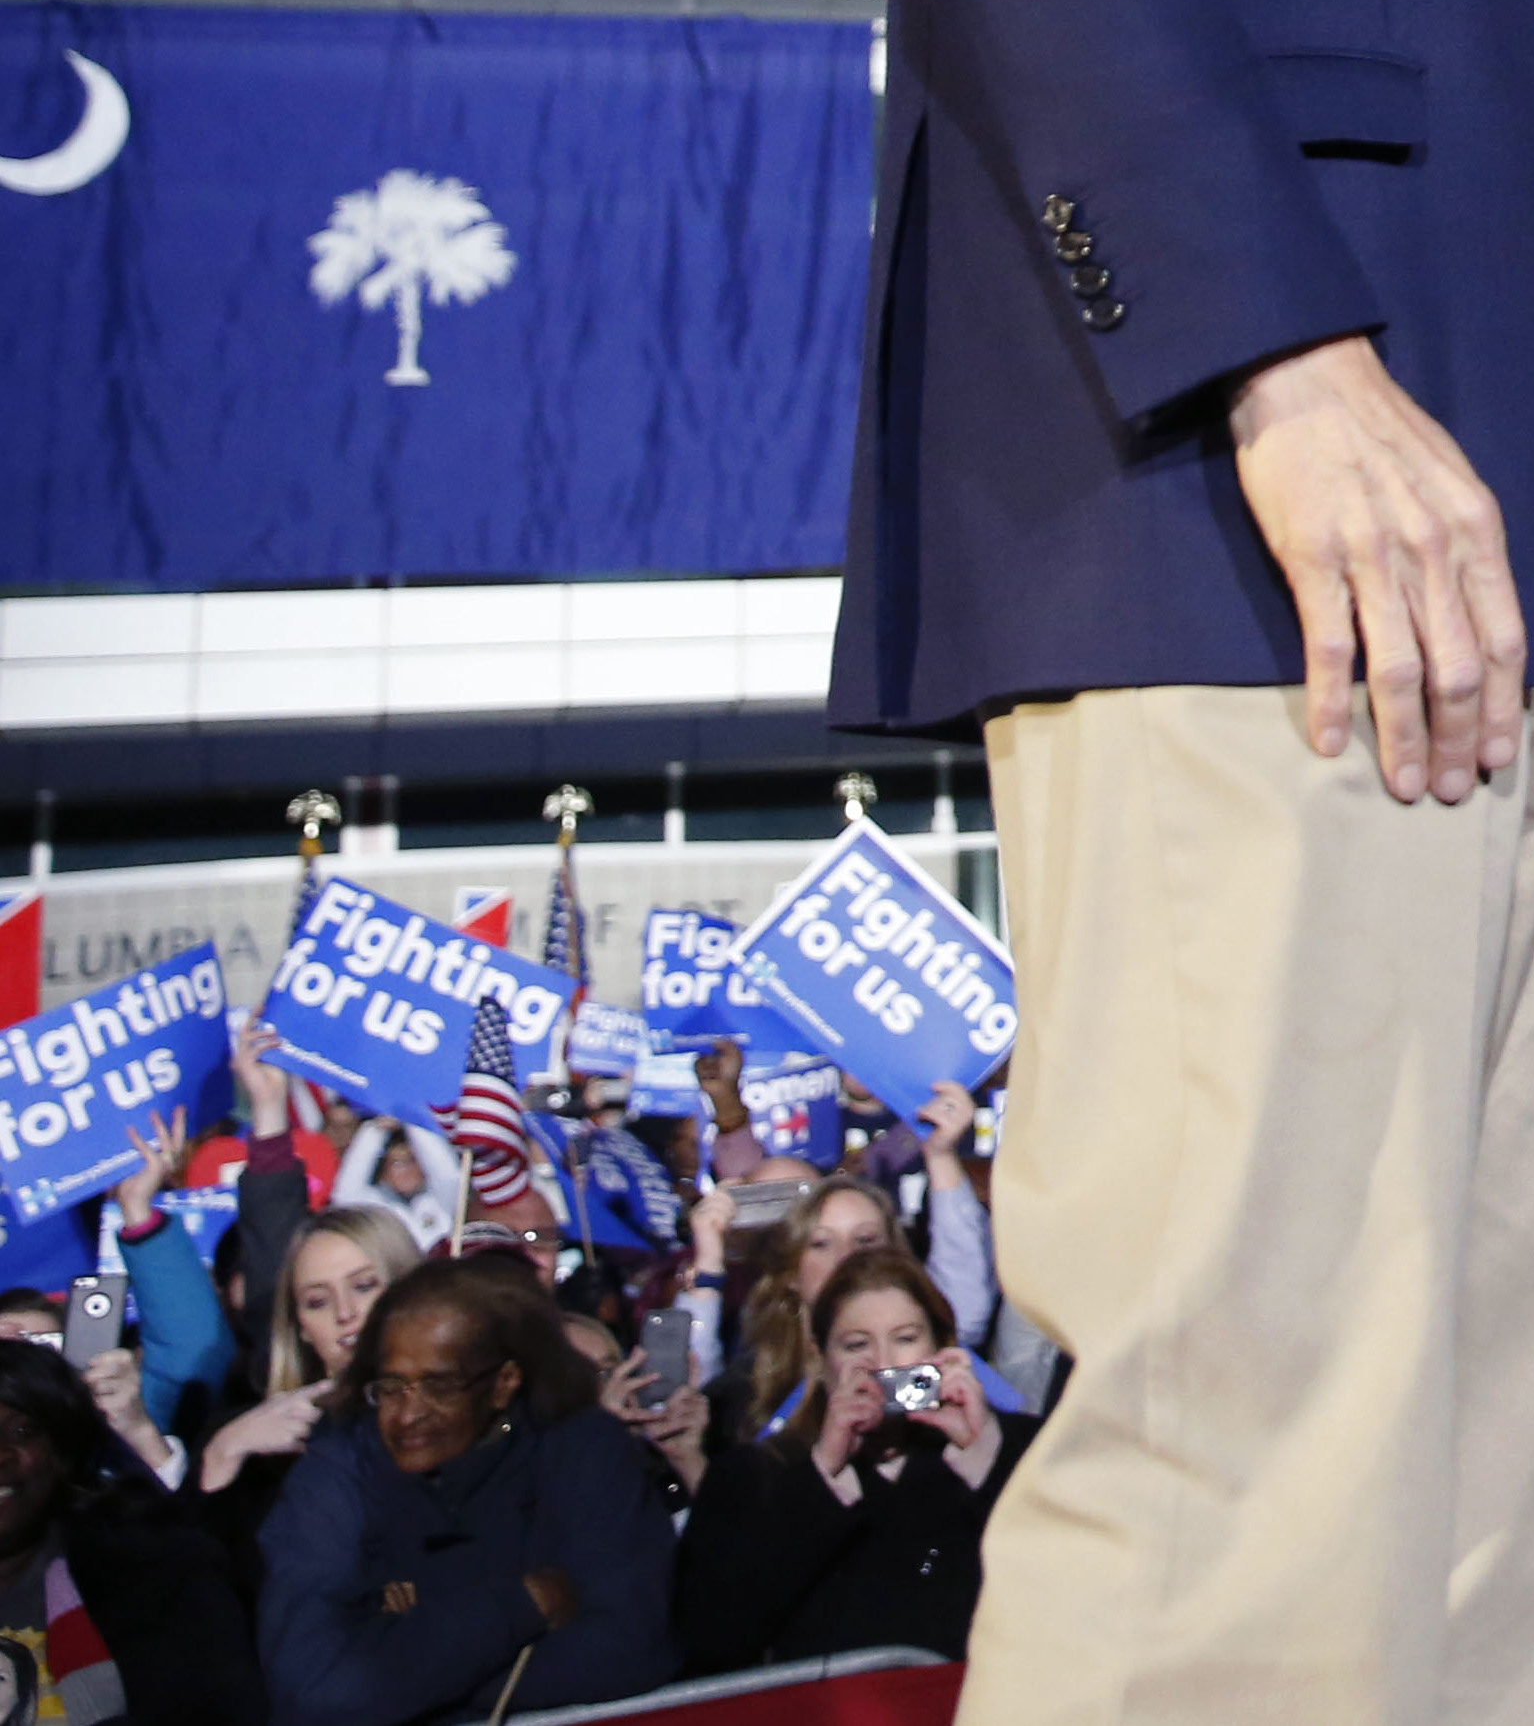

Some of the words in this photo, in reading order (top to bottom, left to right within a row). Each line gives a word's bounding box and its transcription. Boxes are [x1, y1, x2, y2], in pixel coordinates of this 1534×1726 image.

[273, 938, 367, 1017] for
[362, 990, 446, 1055] us
[304, 881, 563, 1045] Fighting
[643, 959, 723, 1009] for
[727, 973, 762, 1007] u
[779, 894, 867, 977] for
[854, 965, 923, 1035] us
[820, 851, 1018, 1055] Fighting
[0, 1082, 96, 1163] for
[103, 1047, 181, 1110] us
[740, 1065, 841, 1112] omen
